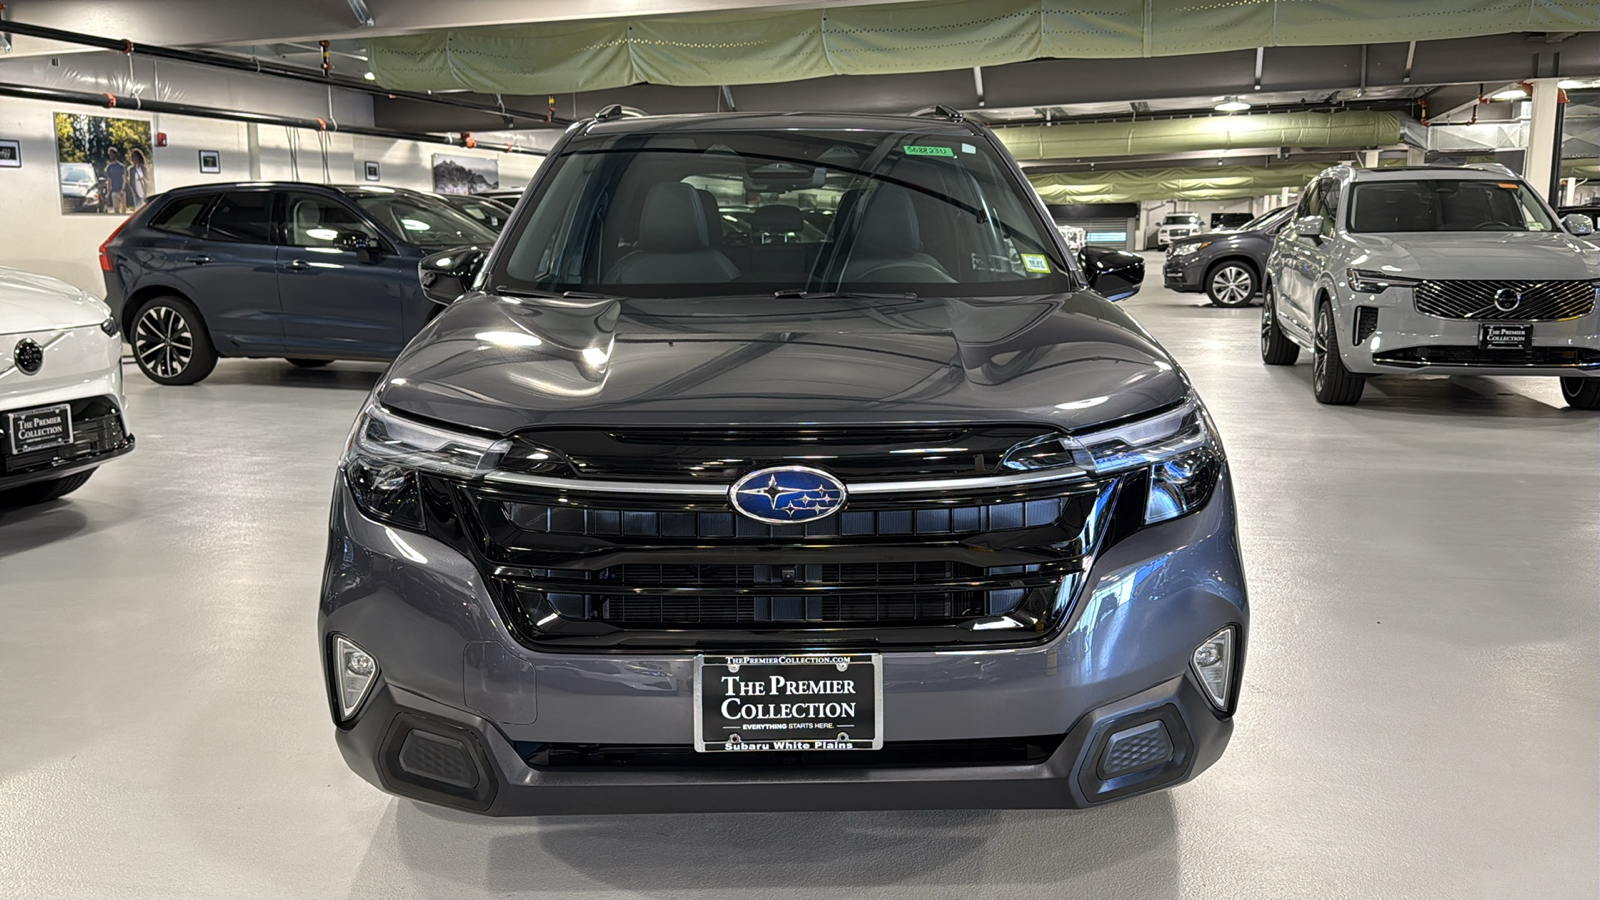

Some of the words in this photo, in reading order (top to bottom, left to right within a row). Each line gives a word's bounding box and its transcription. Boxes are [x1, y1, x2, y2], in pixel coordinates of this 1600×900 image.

[18, 420, 34, 430] THE
[34, 416, 62, 428] PREMIER
[18, 425, 62, 440] COLLECTION
[721, 676, 766, 696] THE
[769, 675, 856, 696] PREMIER
[721, 698, 856, 720] COLLECTION
[724, 742, 770, 750] Subaru
[774, 742, 810, 750] White
[814, 741, 853, 750] Plains
